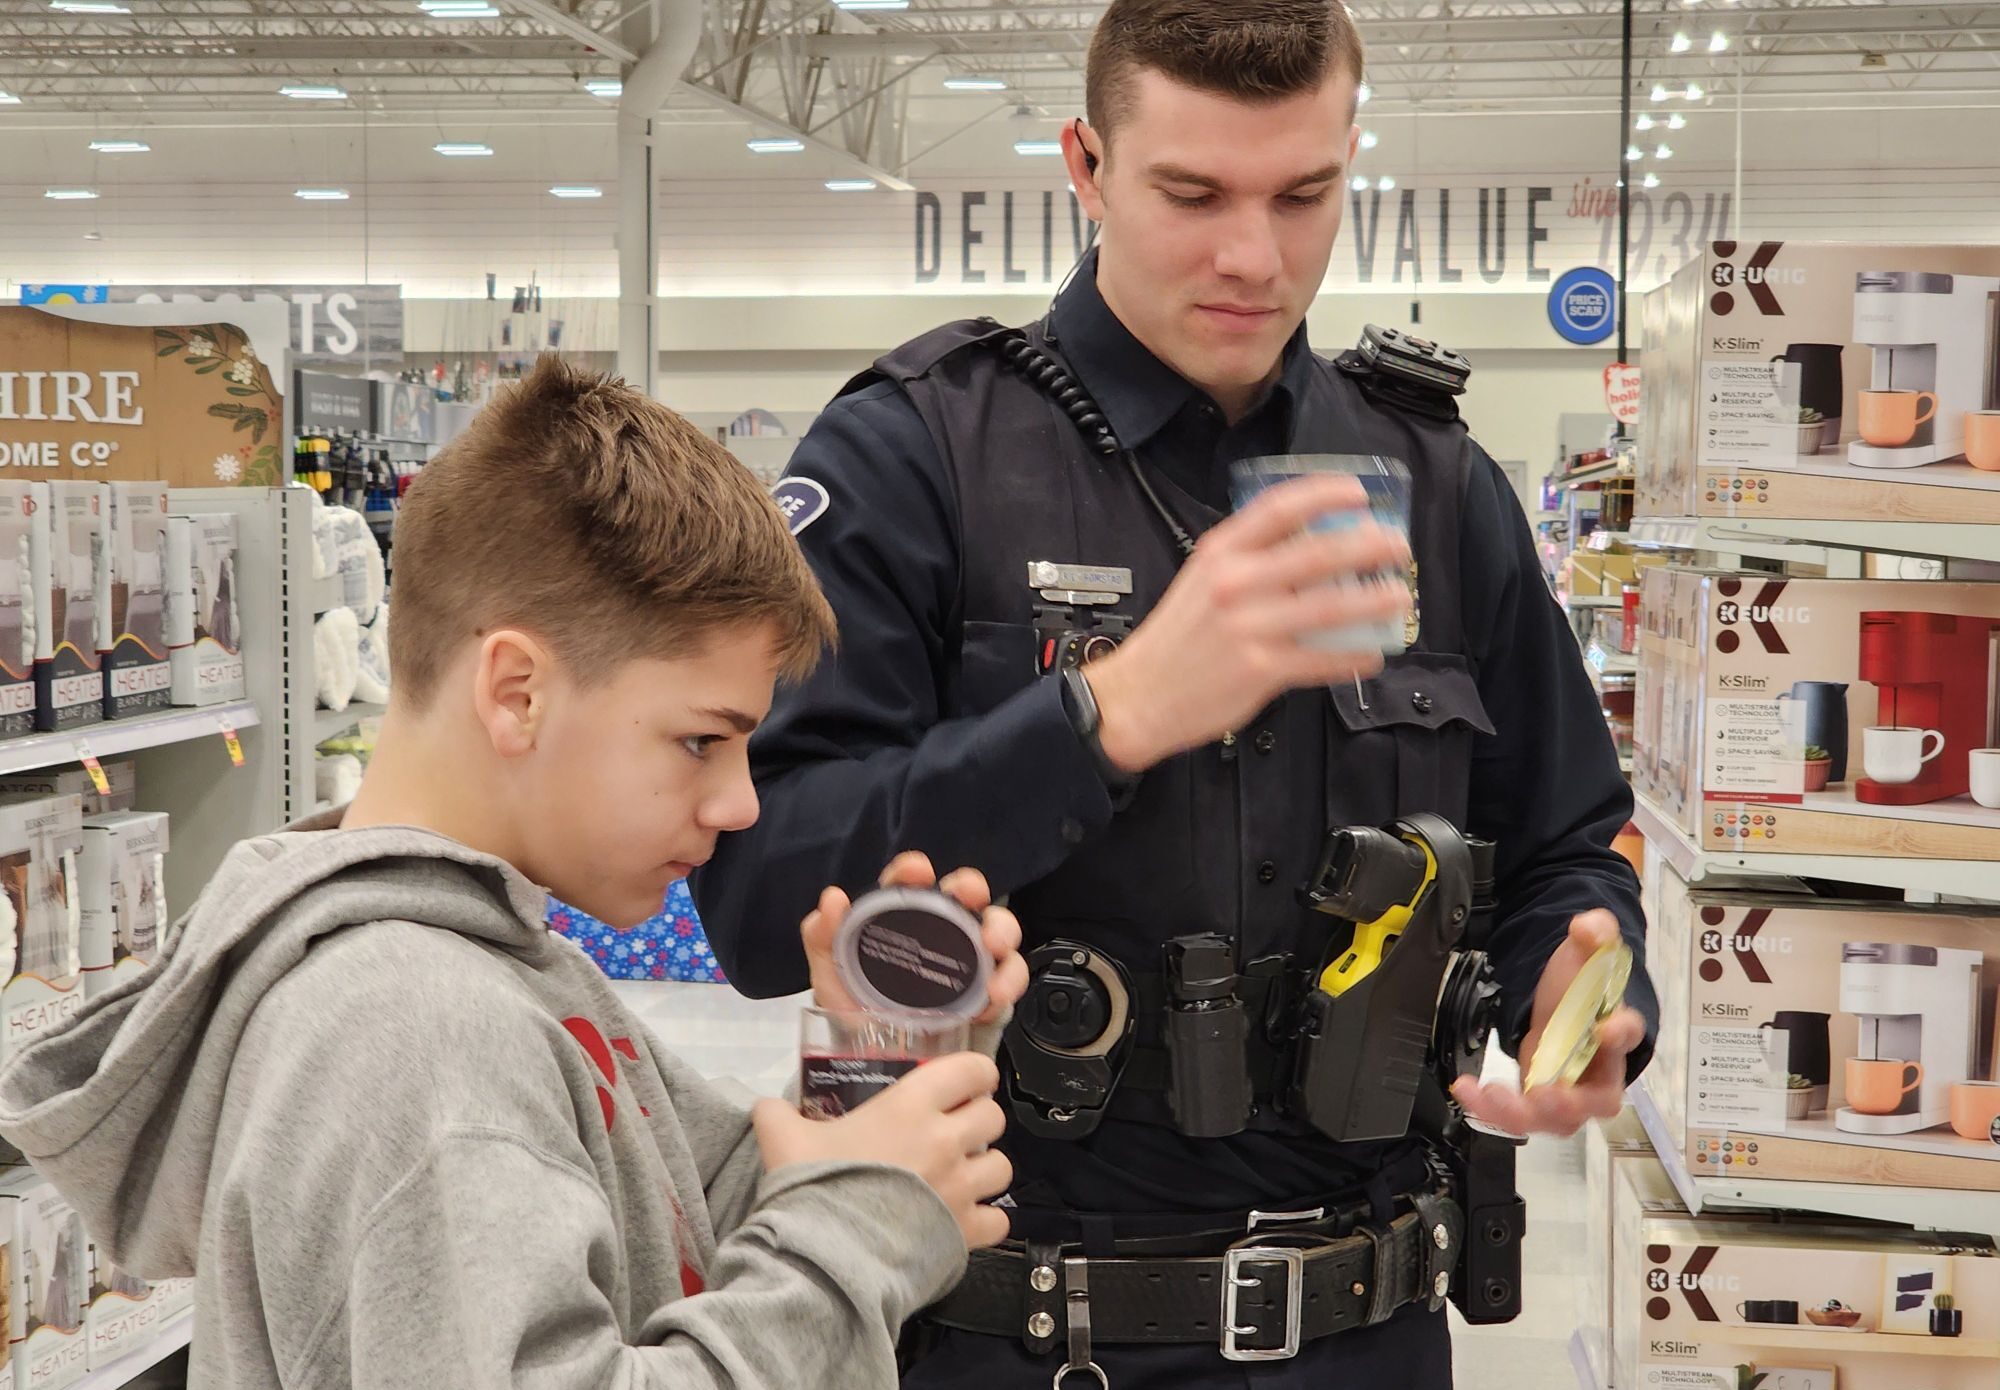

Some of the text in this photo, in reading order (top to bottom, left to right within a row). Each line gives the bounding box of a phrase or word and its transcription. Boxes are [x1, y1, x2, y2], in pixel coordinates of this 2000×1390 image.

[1351, 187, 1552, 284] VALUE
[1714, 266, 1807, 285] KEURIG
[1569, 294, 1603, 305] PRICE
[1569, 305, 1603, 317] SCAN
[1720, 604, 1811, 624] KEURIG
[116, 664, 169, 693] HEATED
[200, 663, 243, 685] HEATED
[57, 675, 102, 704] HEATED
[1703, 933, 1793, 954] KEURIG
[9, 993, 81, 1037] HEATED
[1650, 1271, 1740, 1291] KEURIG
[94, 1304, 157, 1348] HEATED
[30, 1338, 87, 1386] HEATED
